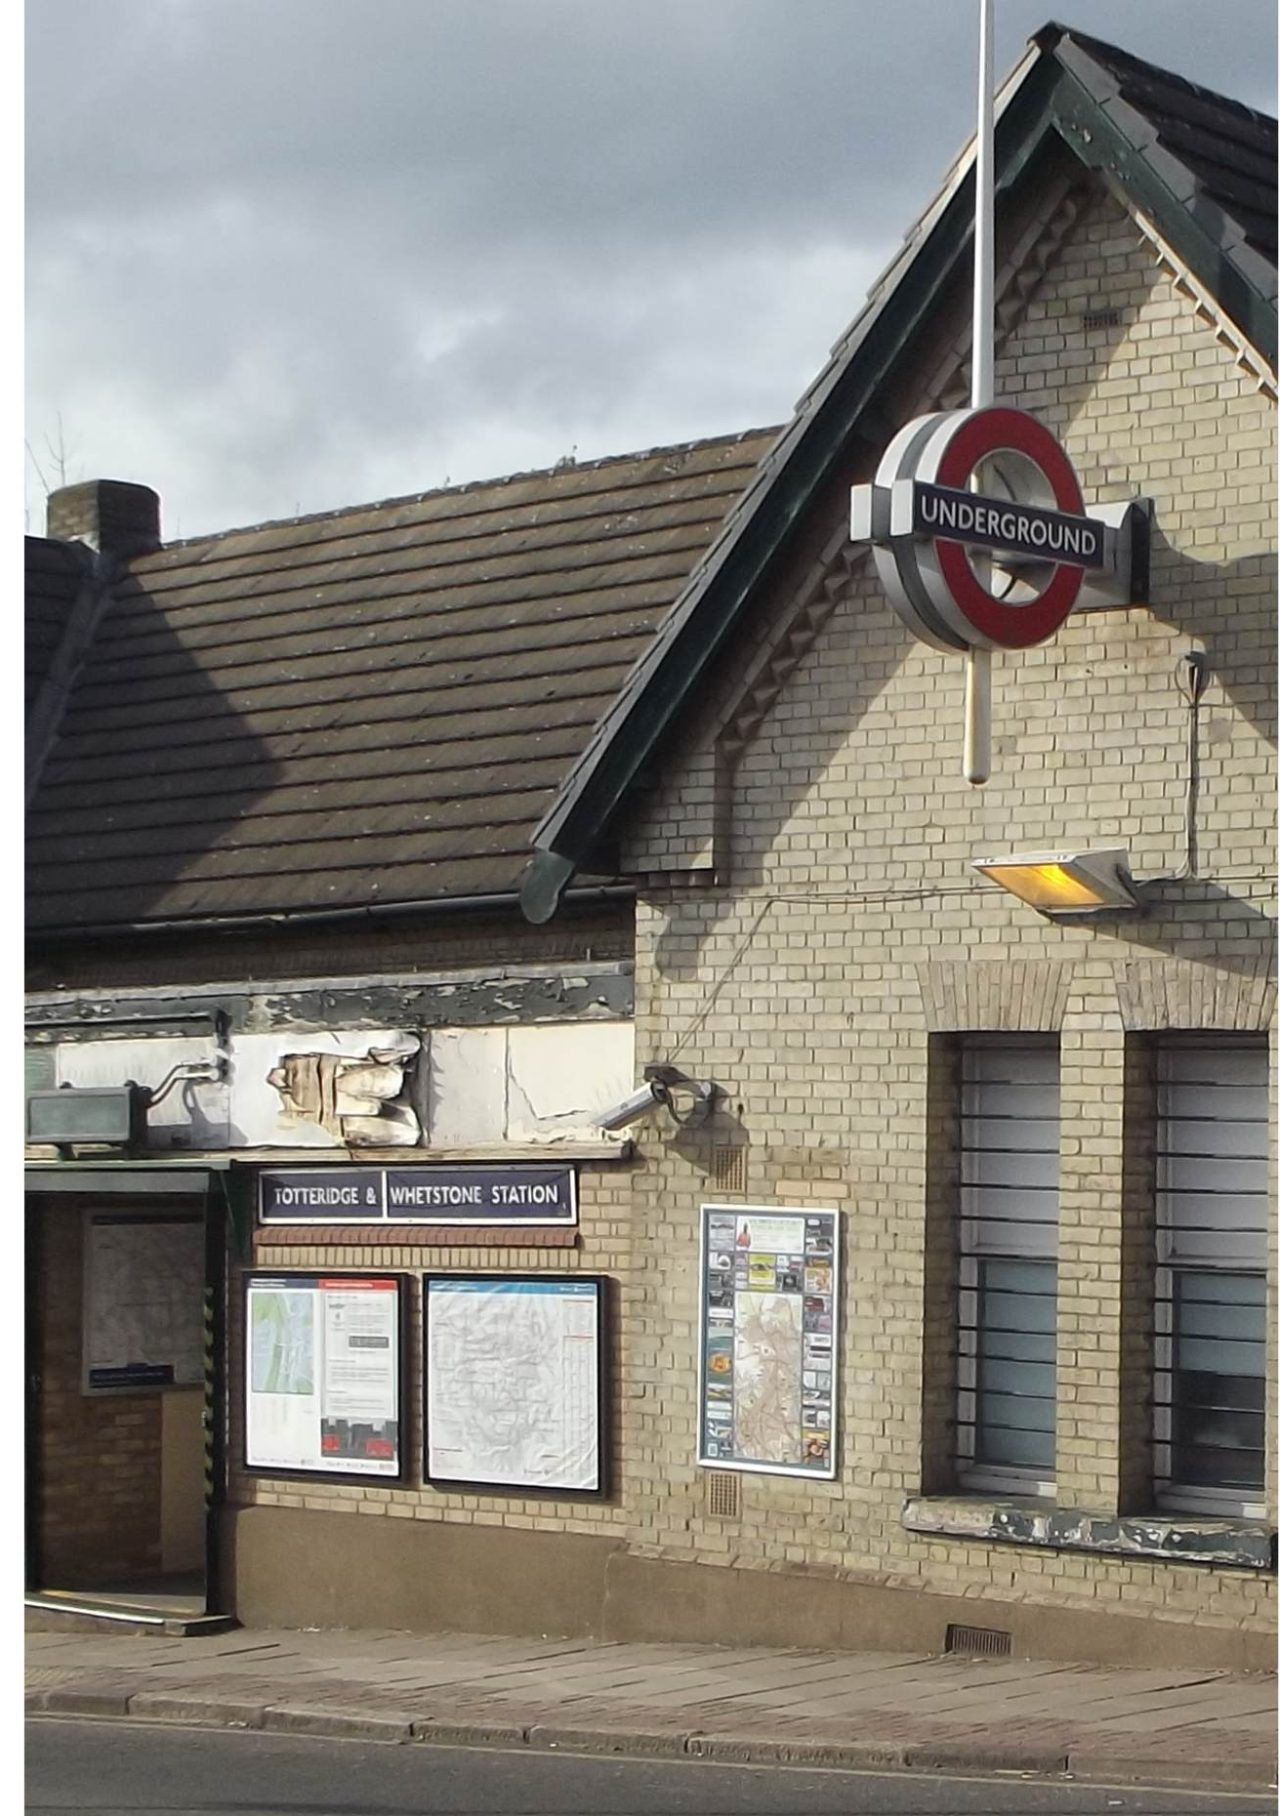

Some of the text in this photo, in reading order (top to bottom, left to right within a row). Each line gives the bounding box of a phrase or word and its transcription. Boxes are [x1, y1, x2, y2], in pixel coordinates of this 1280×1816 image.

[921, 495, 1096, 555] UNDERGROUND
[274, 1185, 559, 1205] TOTTERIDGE & WHETSTONE STATION
